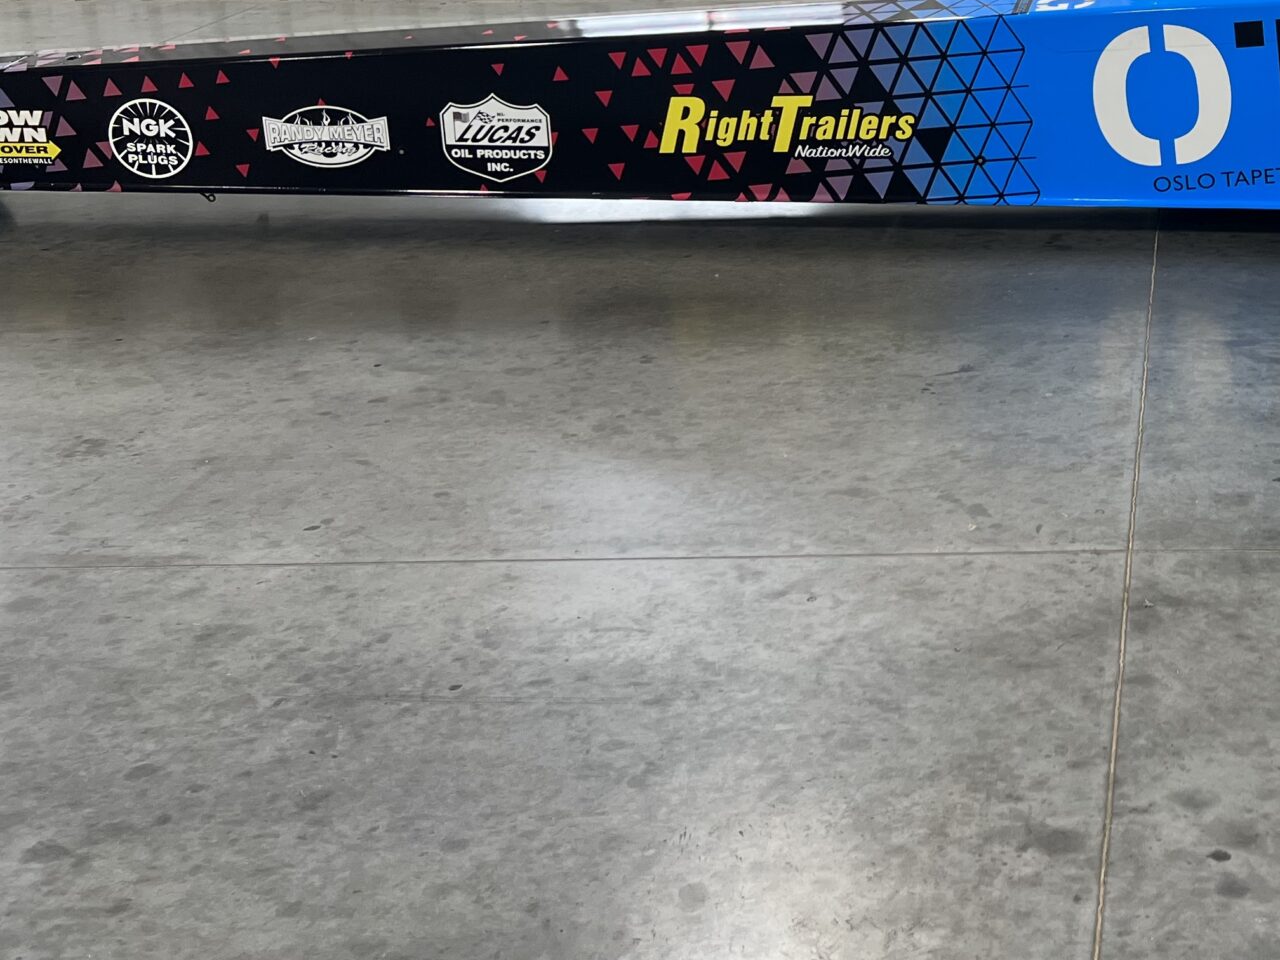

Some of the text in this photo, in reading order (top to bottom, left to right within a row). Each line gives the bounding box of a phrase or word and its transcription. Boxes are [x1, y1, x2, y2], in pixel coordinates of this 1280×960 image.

[122, 117, 176, 139] NGK
[269, 122, 385, 144] RANDY MEYER
[455, 125, 541, 143] LUCAS
[1, 146, 49, 154] OVER
[127, 142, 177, 154] SPARK
[301, 143, 358, 156] Racing
[451, 149, 546, 159] OIL PRODUCTS
[794, 144, 892, 158] NationWide
[128, 153, 179, 166] PLUGS
[486, 162, 514, 172] INC.
[1153, 173, 1216, 193] OSLO
